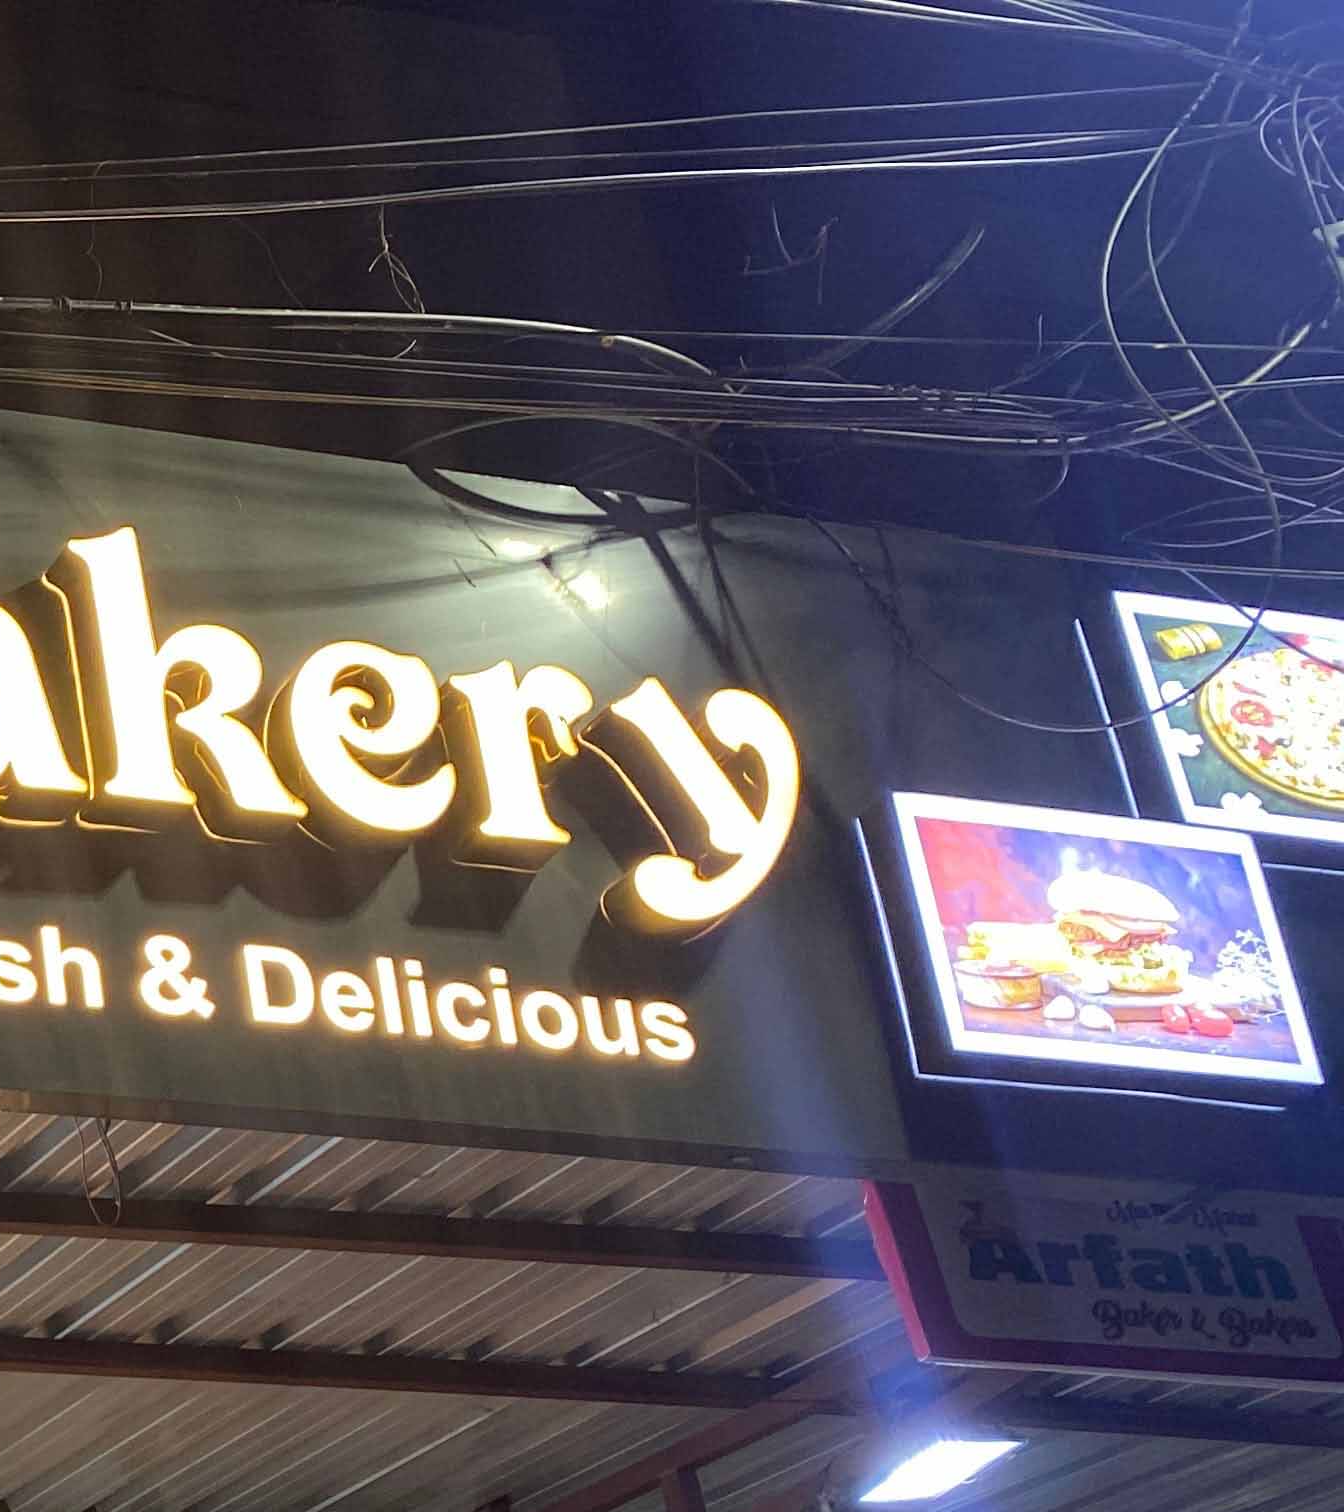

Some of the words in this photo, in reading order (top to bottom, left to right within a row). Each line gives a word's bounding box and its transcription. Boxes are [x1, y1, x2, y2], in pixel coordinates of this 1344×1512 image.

[138, 933, 216, 1020] &
[242, 943, 697, 1063] Delicious
[967, 1233, 1297, 1299] Arfath
